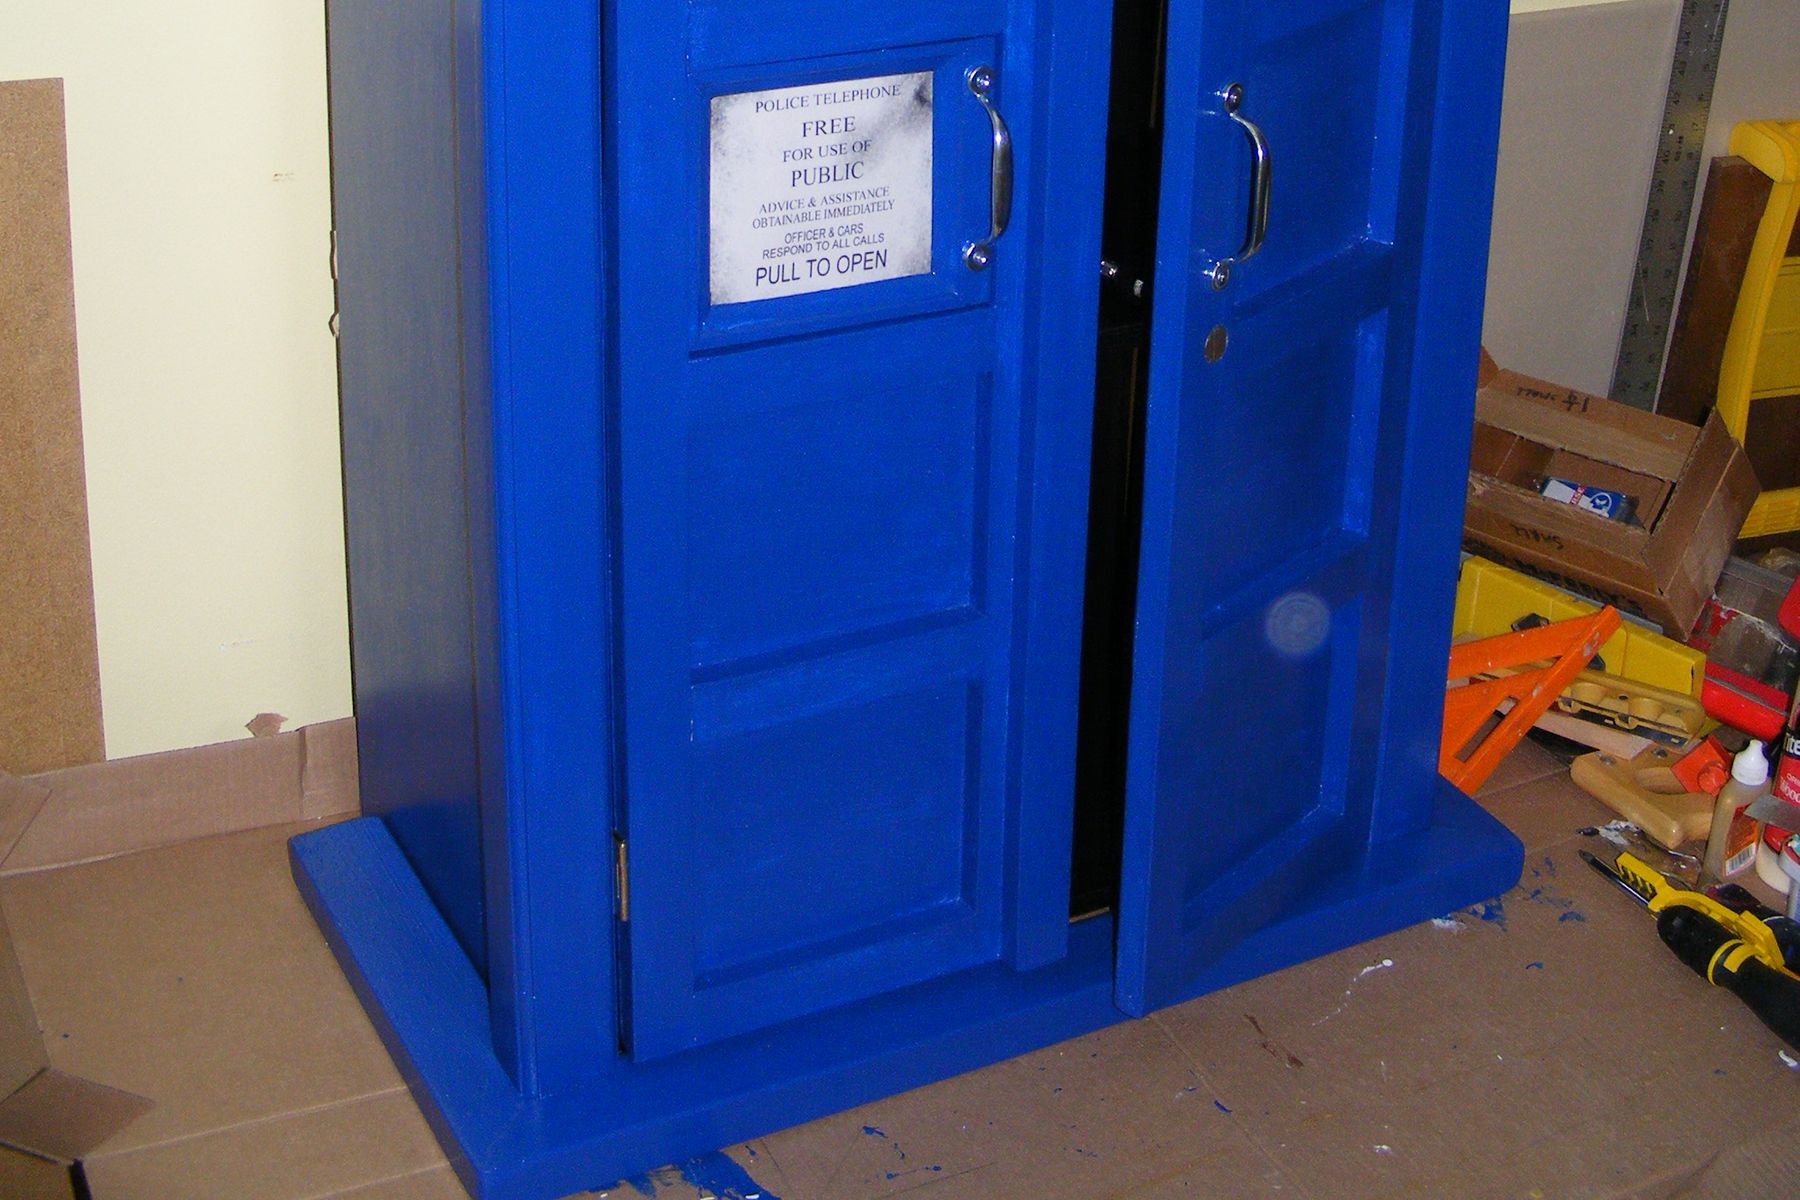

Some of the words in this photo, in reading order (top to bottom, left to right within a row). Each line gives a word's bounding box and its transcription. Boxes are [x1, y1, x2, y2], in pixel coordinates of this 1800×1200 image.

[755, 95, 809, 113] POLICE
[814, 84, 901, 106] TELEPHONE
[802, 116, 856, 137] FREE
[783, 148, 813, 162] FOR
[818, 143, 848, 158] USE
[852, 139, 872, 153] OF
[792, 161, 865, 187] PUBLIC
[759, 199, 805, 214] ADVICE
[808, 197, 817, 208] &
[820, 186, 890, 206] ASSISTANCE
[752, 211, 821, 229] OBTAINABLE
[824, 199, 896, 220] IMMEDIATELY
[762, 243, 813, 260] RESPOND
[816, 241, 830, 251] TO
[832, 238, 850, 250] ALL
[853, 233, 885, 247] CALLS
[784, 228, 826, 244] OFFICER
[829, 227, 835, 238] &
[837, 223, 864, 236] CARS
[756, 262, 800, 286] PULL
[806, 257, 830, 278] TO
[837, 249, 887, 274] OPEN
